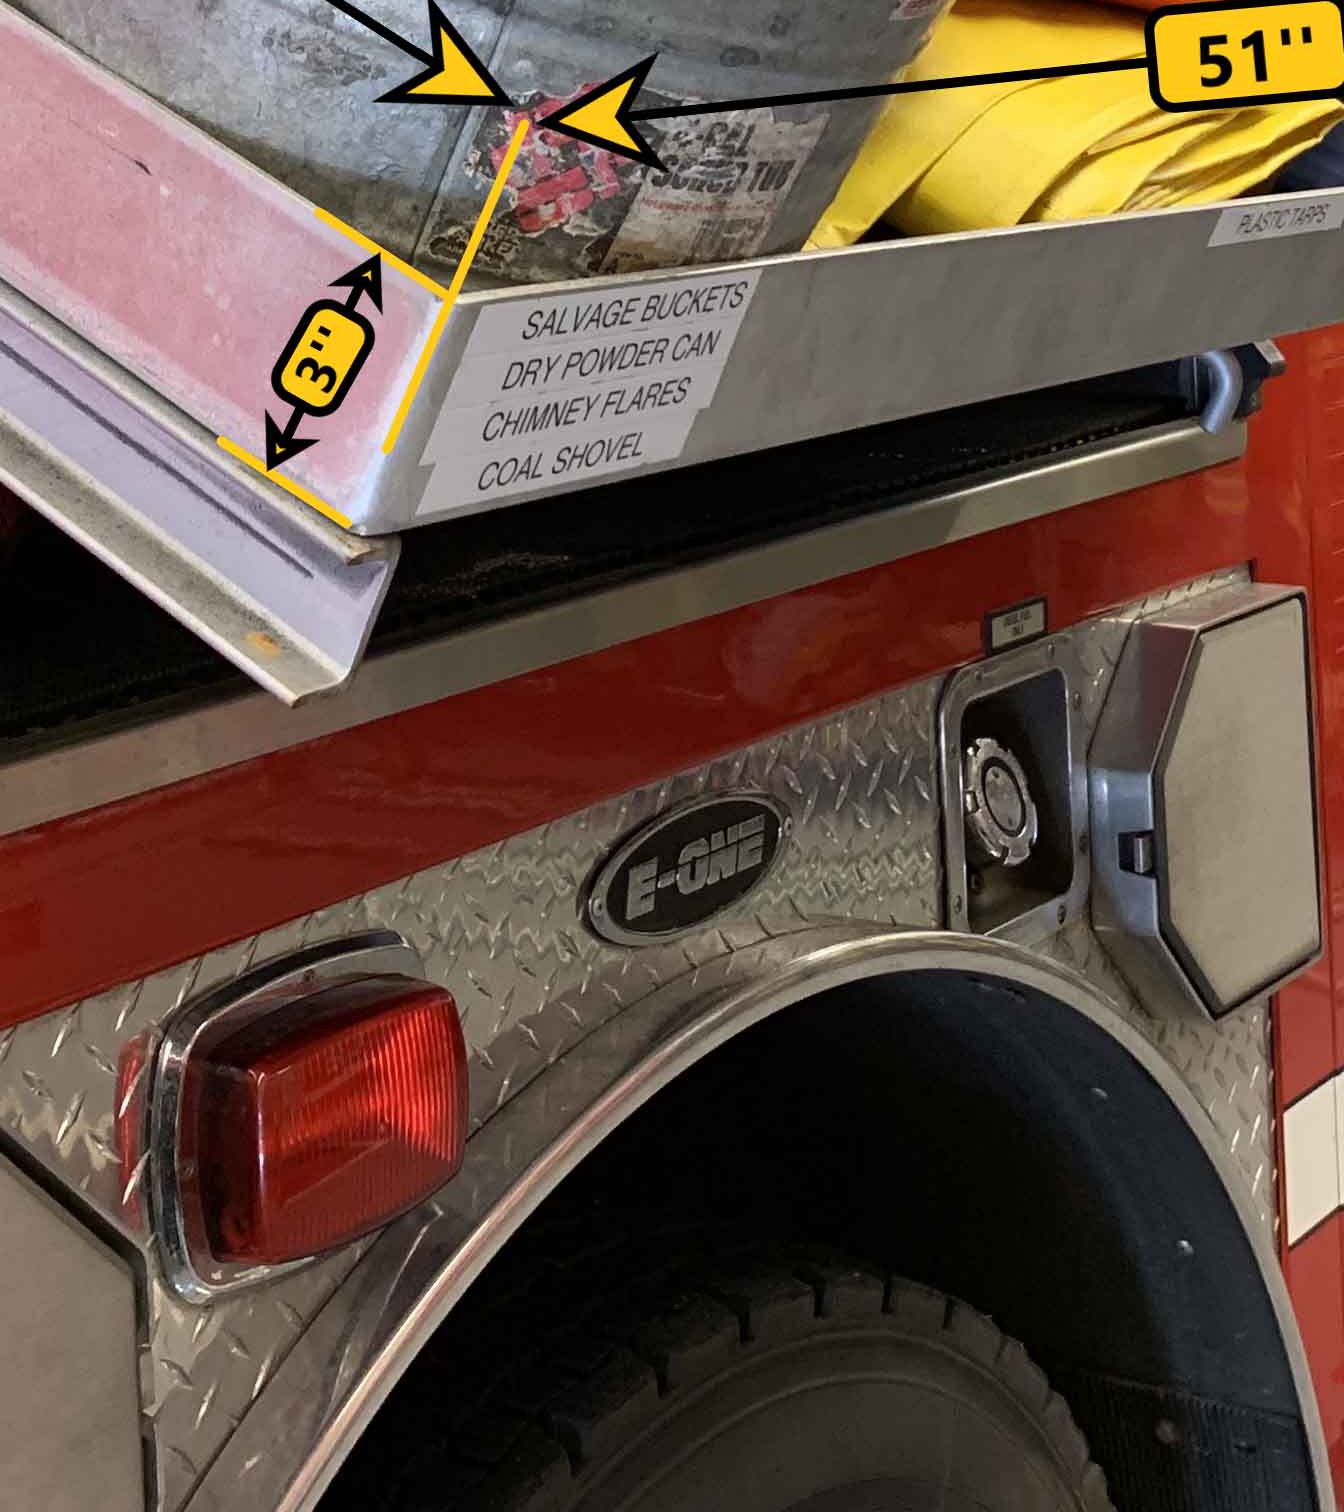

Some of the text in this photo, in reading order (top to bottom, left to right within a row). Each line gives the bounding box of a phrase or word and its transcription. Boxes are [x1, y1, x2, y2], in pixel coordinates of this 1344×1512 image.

[522, 281, 749, 340] SALVAGE BUCKETS
[501, 329, 722, 391] DRY POWDER CAN
[482, 376, 692, 441] CHIMNEY FLARES
[477, 431, 644, 490] COAL SHOVEL
[625, 813, 766, 921] E-ONE
